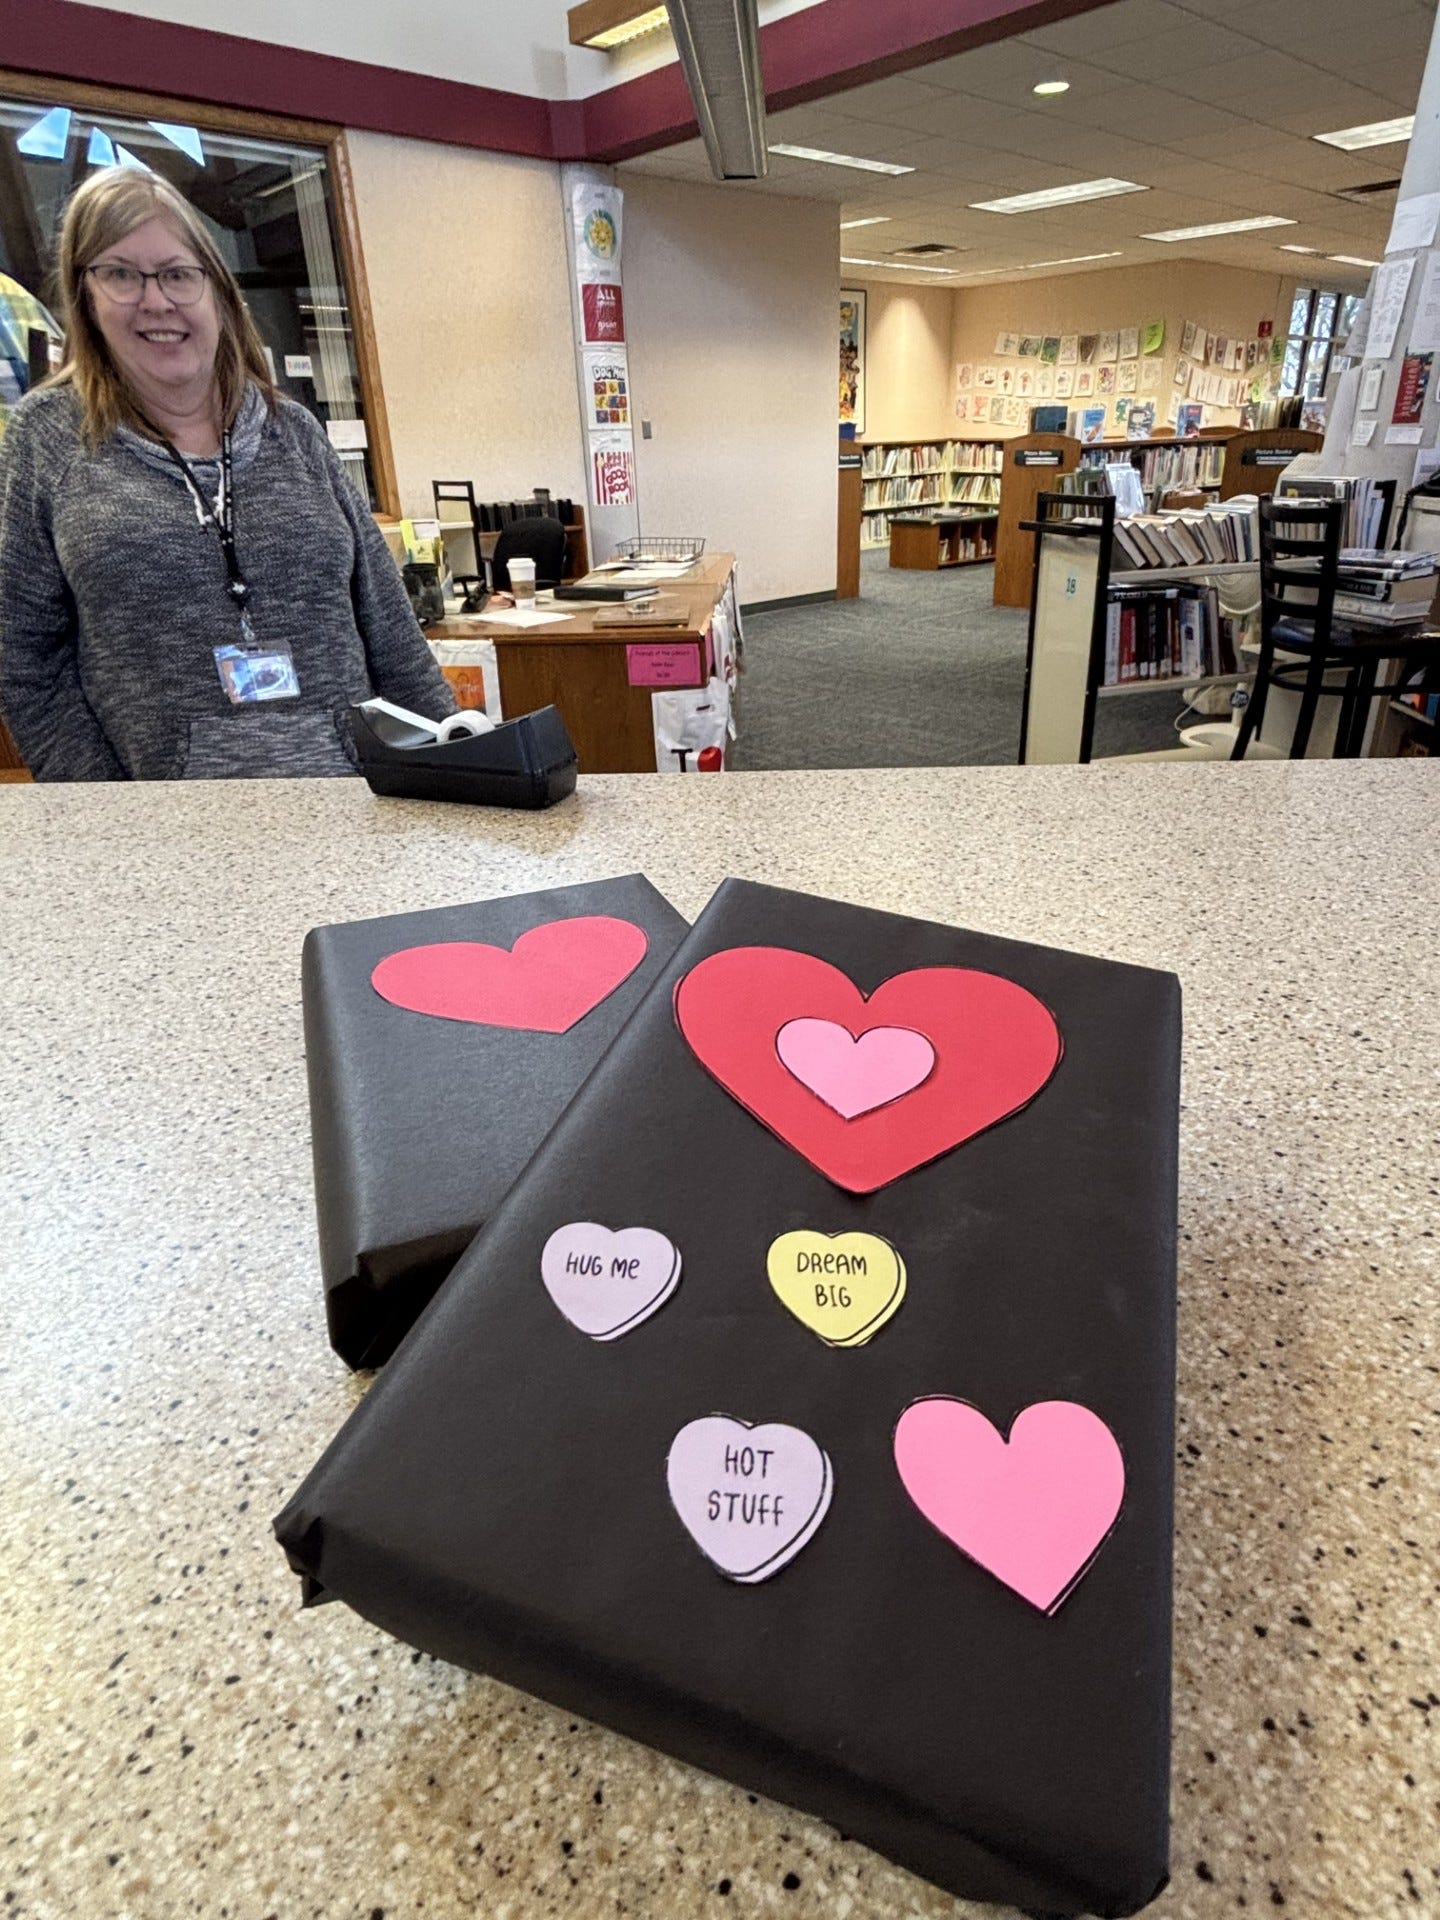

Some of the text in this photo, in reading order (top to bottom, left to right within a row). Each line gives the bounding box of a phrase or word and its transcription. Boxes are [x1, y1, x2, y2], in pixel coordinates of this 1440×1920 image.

[592, 365, 612, 381] DOG
[606, 468, 627, 484] GOOD
[608, 480, 629, 495] BOOK
[1066, 577, 1077, 594] 18
[566, 1251, 603, 1276] HUG
[815, 1283, 852, 1308] BIG
[725, 1444, 775, 1479] HOT
